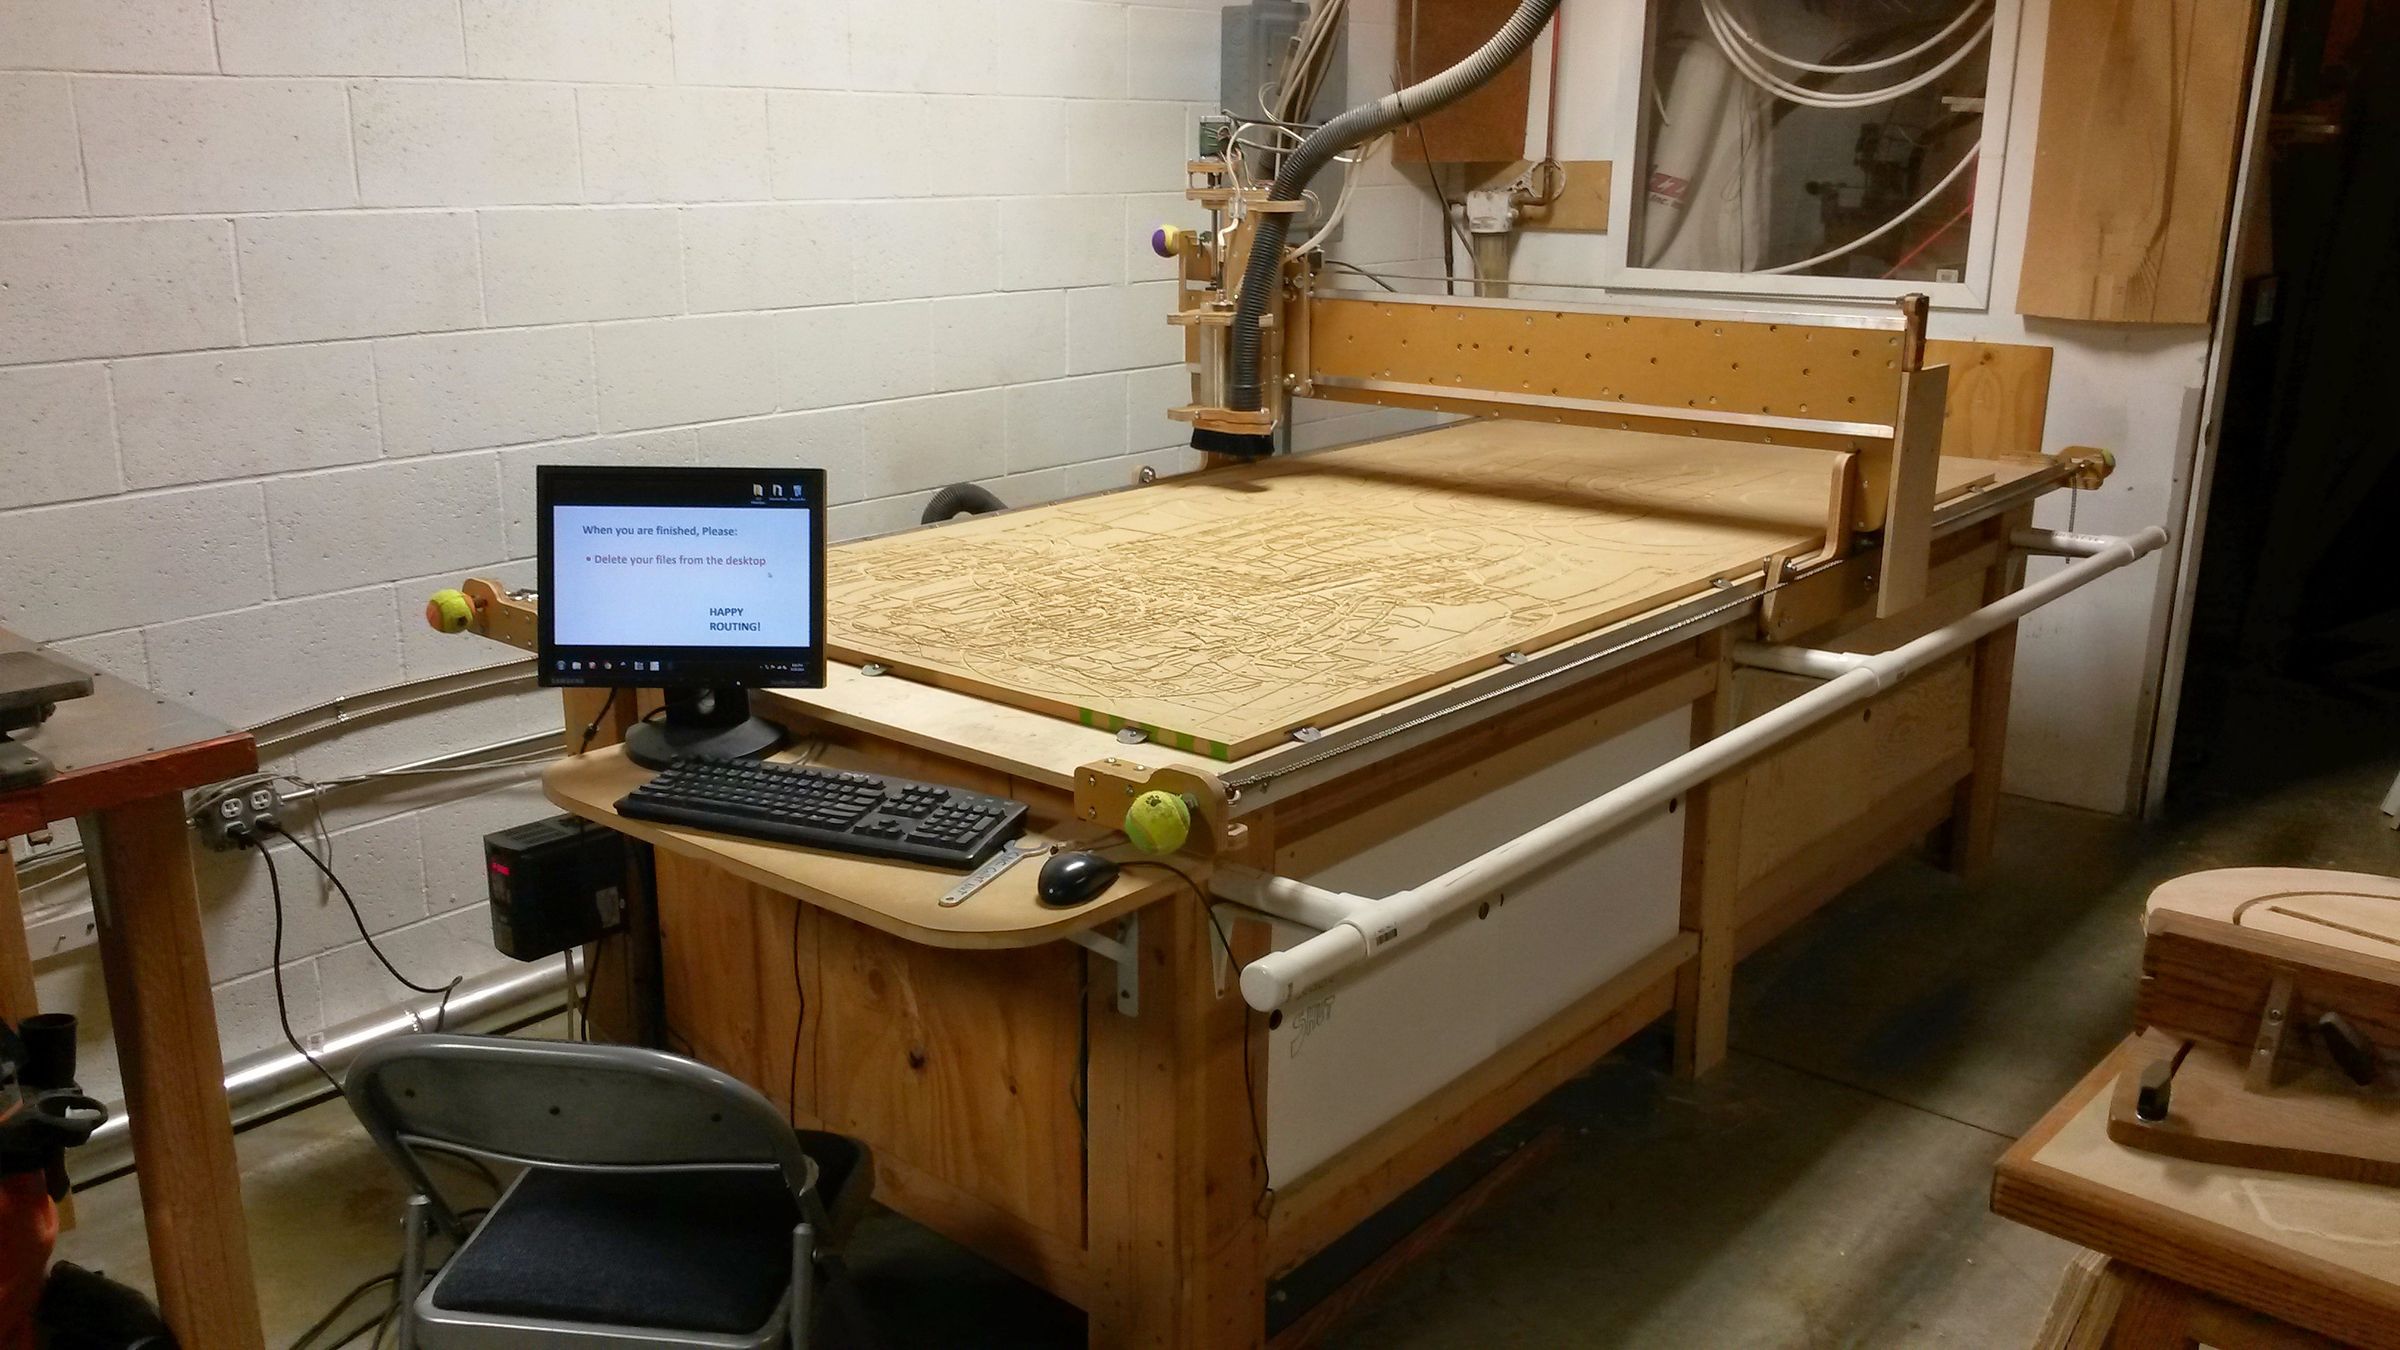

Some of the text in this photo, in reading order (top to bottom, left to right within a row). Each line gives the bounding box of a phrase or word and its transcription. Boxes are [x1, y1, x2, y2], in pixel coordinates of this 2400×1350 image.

[582, 525, 738, 537] When you are finished, Please:
[594, 555, 767, 567] Delete your files from the desktop
[709, 607, 744, 617] HAPPY
[709, 621, 761, 632] ROUTING!
